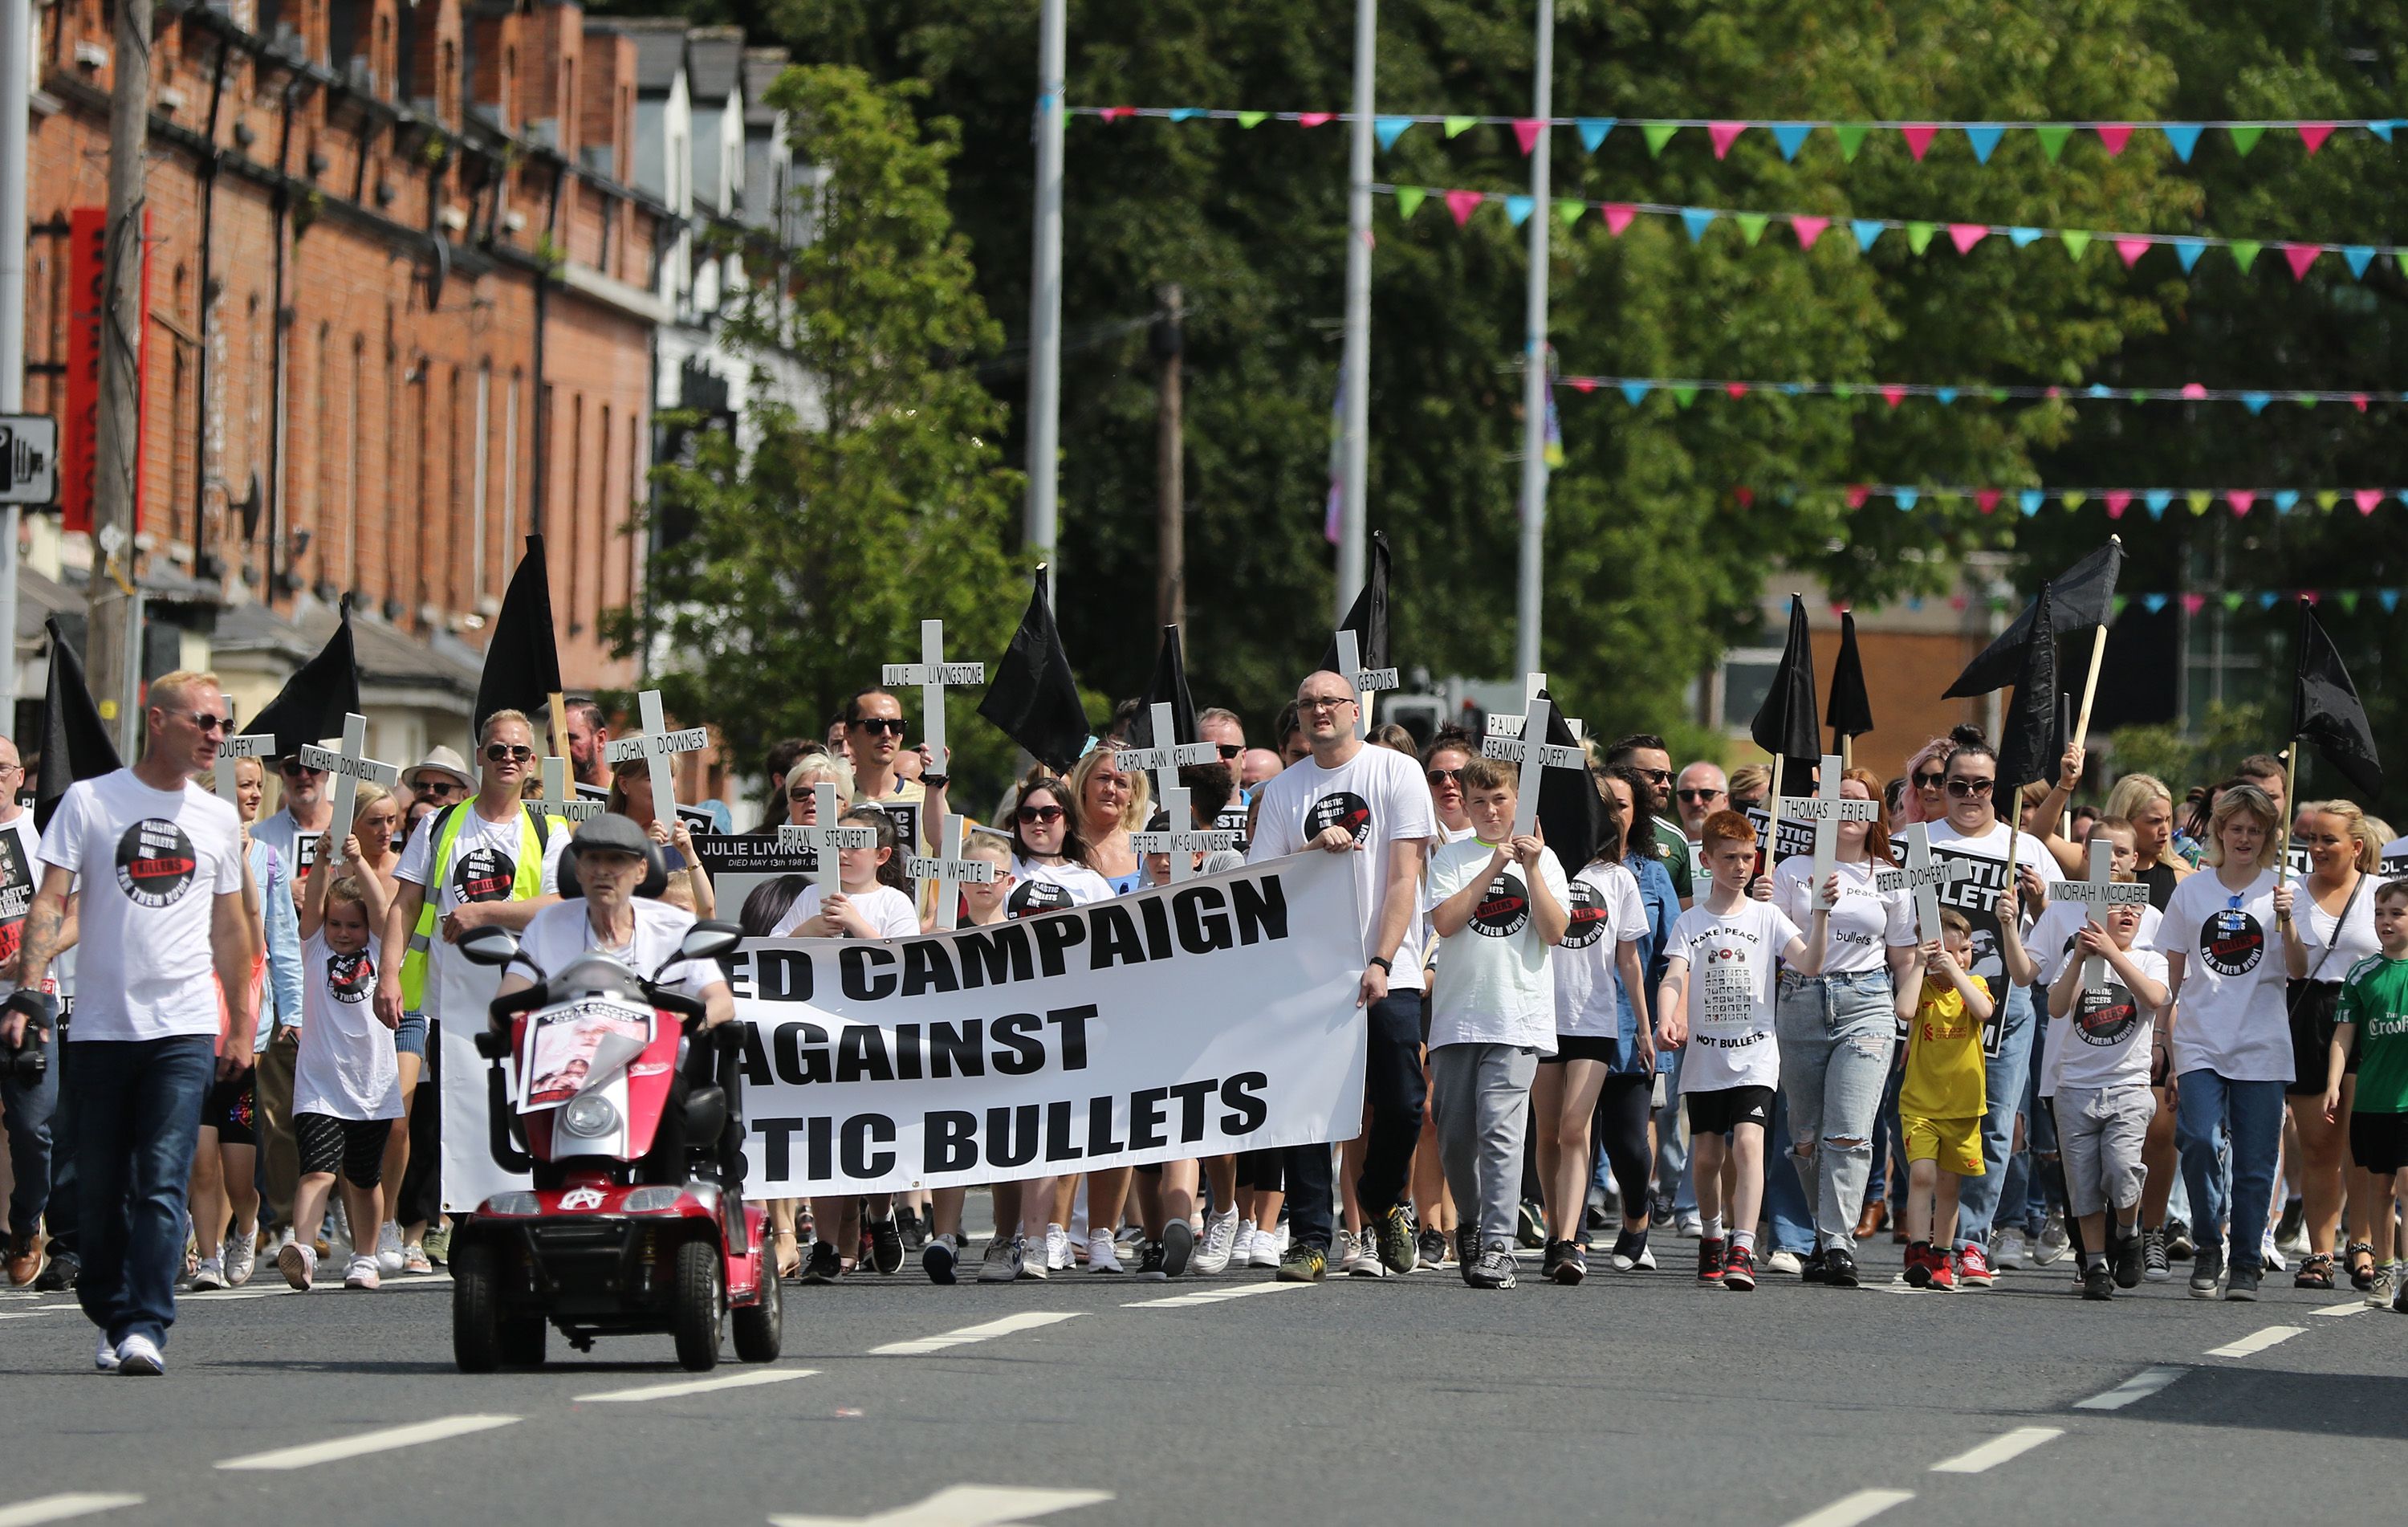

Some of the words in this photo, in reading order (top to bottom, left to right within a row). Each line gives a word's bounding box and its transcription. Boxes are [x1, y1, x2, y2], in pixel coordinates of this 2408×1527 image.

[887, 668, 909, 686] JULIE
[928, 666, 982, 684] LIVINGSTONE
[1358, 673, 1393, 691] GEDDIS
[1491, 716, 1517, 735] PAUL
[219, 739, 254, 759] DUFFY
[616, 740, 645, 760] JOHN
[657, 731, 704, 754] DOWNES
[1485, 741, 1525, 763] SEAMUS
[1538, 747, 1568, 767] DUFFY
[301, 748, 335, 772] MICHAEL
[340, 757, 378, 782] DONNELLY
[1117, 755, 1145, 772] CAROL
[1150, 751, 1167, 768] ANN
[1173, 747, 1197, 767] KELLY
[1316, 797, 1344, 810] PLASTIC
[1785, 800, 1828, 819] THOMAS
[1841, 802, 1871, 822] FRIEL
[1317, 807, 1344, 819] BULLETS
[141, 820, 179, 837] PLASTIC
[1319, 819, 1332, 829] ARE
[140, 831, 177, 850] BULLETS
[783, 829, 810, 847] BRIAN
[825, 829, 868, 849] STEWERT
[1353, 824, 1369, 844] OW!
[138, 845, 157, 860] ARE
[702, 842, 749, 856] JULIE
[1133, 835, 1158, 853] PETER
[138, 859, 182, 875] KILLERS
[468, 861, 495, 873] BULLETS
[728, 859, 748, 867] DIED
[770, 858, 786, 867] 13th
[788, 858, 809, 867] 1981,
[909, 859, 939, 879] KEITH
[947, 861, 982, 882] WHITE
[467, 870, 481, 879] ARE
[1877, 872, 1903, 892] PETER
[1910, 864, 1953, 887] DOHERTY
[117, 865, 135, 891] BAN
[131, 886, 163, 906] THEM
[165, 874, 191, 905] NOW!
[1032, 881, 1060, 894] PLASTIC
[1846, 887, 1882, 898] peace
[2055, 884, 2096, 902] NORAH
[1027, 898, 1041, 908] ARE
[1029, 888, 1058, 902] BULLETS
[1479, 898, 1513, 915] KILLERS
[1478, 922, 1503, 936] THEM
[1506, 912, 1527, 935] NOW!
[839, 875, 1288, 1002] CAMPAIGN
[1561, 935, 1581, 948] HEM
[1584, 922, 1605, 946] NOW!
[1690, 928, 1720, 947] MAKE
[1725, 927, 1759, 945] PEACE
[1836, 929, 1872, 946] bullets
[2217, 931, 2231, 940] ARE
[2201, 947, 2217, 966] BAN
[2216, 962, 2241, 975] THEM
[2242, 948, 2262, 971] NOW!
[339, 992, 364, 1002] THEM
[2085, 996, 2112, 1004] BULLETS
[2089, 1007, 2124, 1025] KILLERS
[1696, 1033, 1717, 1047] NOT
[1719, 1031, 1765, 1049] BULLETS
[2075, 1021, 2089, 1040] BAN
[2087, 1034, 2113, 1045] THEM
[2113, 1020, 2135, 1043] NOW!
[717, 1004, 1100, 1086] AGAINST
[922, 1071, 1268, 1175] BULLETS
